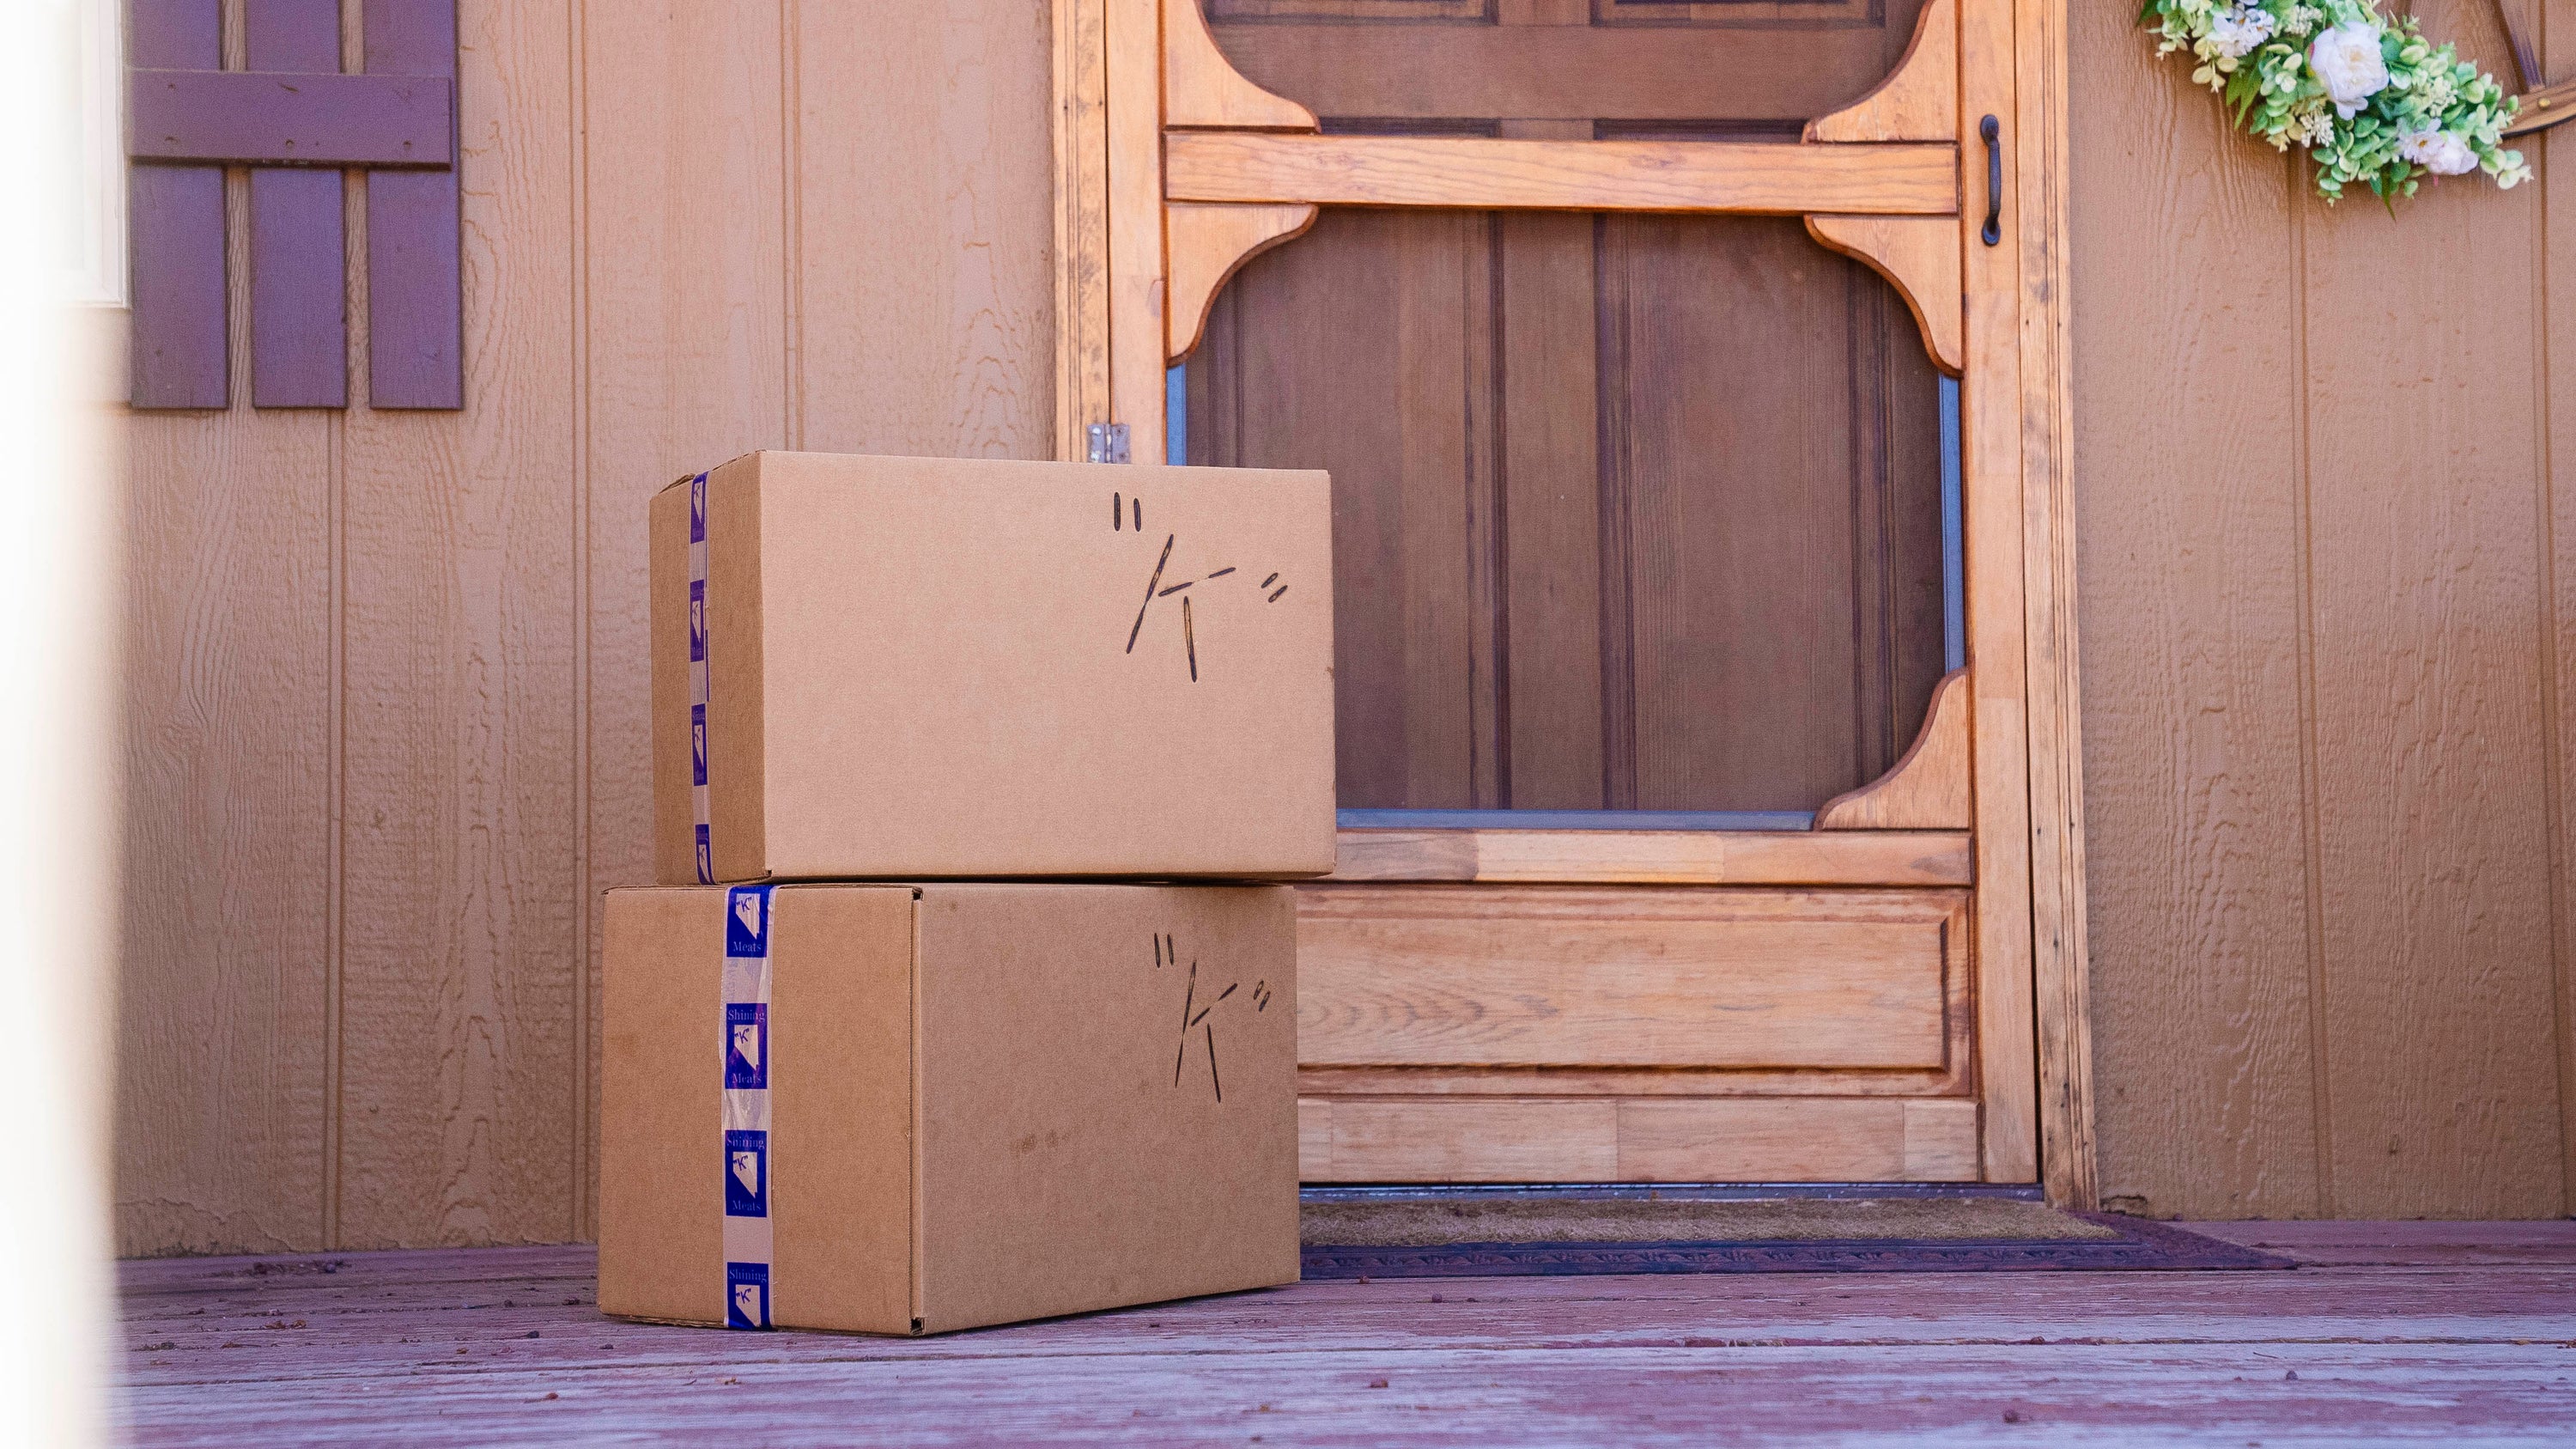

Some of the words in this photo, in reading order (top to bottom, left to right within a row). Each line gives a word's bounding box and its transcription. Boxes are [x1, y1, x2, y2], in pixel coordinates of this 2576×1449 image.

[733, 941, 762, 953] Meats
[727, 1009, 766, 1023] Shining
[732, 1073, 762, 1084] Meats
[726, 1135, 765, 1149] Shining
[732, 1200, 762, 1211] Meats
[729, 1269, 767, 1283] Shining
